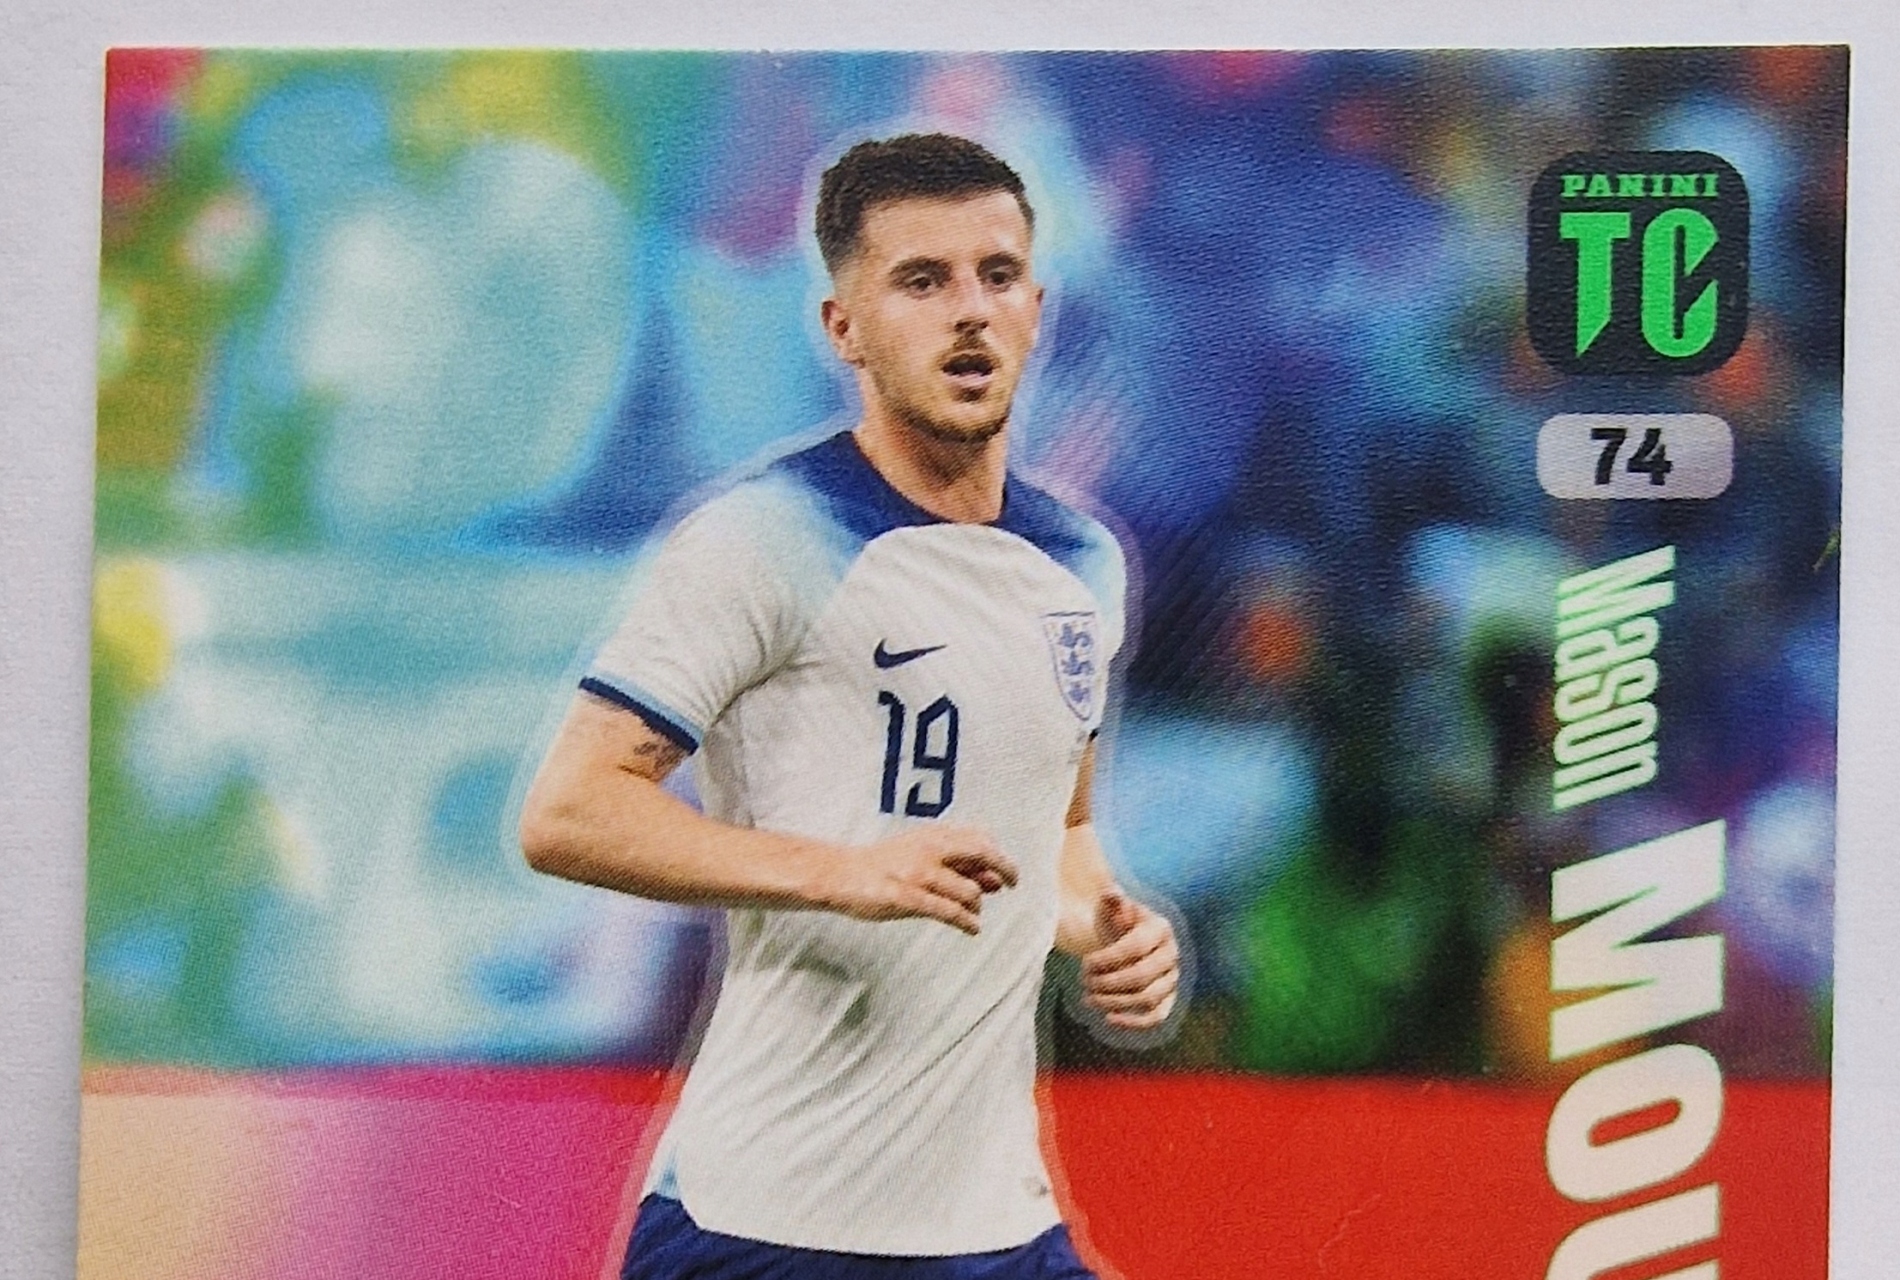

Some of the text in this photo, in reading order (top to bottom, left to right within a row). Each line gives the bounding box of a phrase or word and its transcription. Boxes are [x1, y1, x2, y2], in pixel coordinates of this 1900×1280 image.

[1560, 173, 1719, 198] PANINI
[1559, 208, 1719, 358] TC
[1589, 427, 1673, 486] 74
[1552, 544, 1676, 811] Mason
[877, 690, 960, 818] 19
